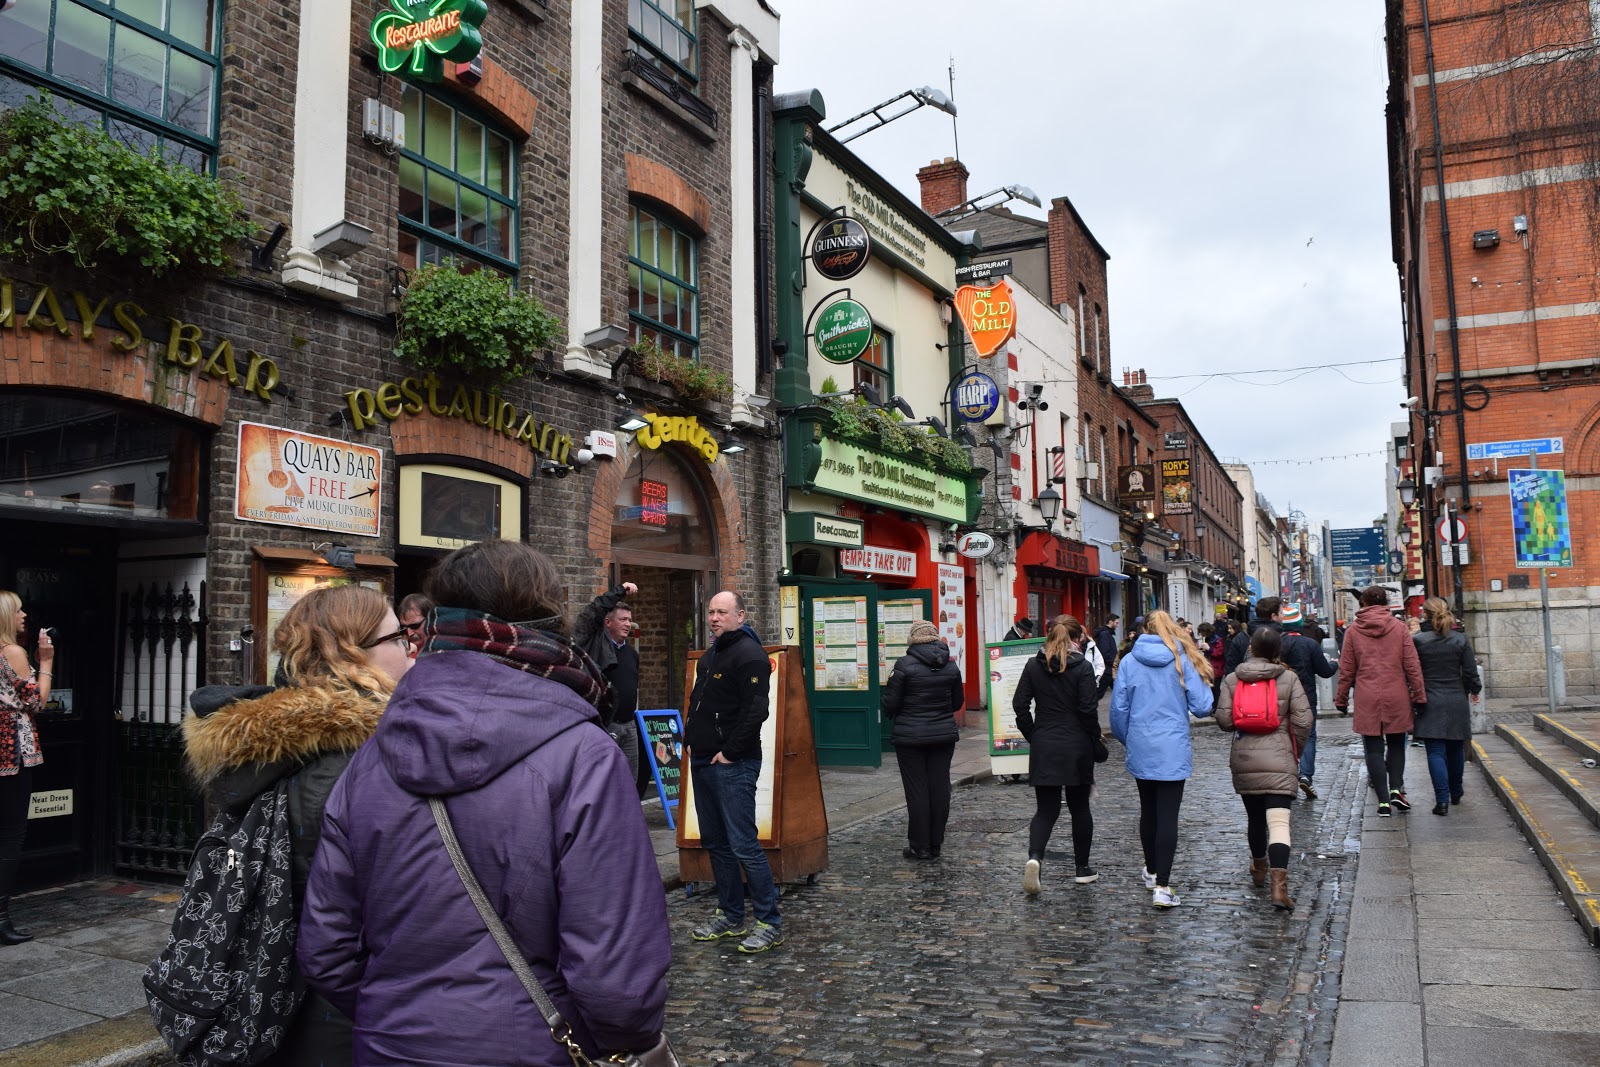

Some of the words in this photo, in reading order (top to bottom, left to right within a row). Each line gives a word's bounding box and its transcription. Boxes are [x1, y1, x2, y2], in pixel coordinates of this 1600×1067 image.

[846, 180, 861, 206] The
[862, 194, 876, 215] Old
[876, 204, 889, 226] Mill
[890, 214, 926, 254] Restaurant
[815, 235, 864, 252] GUINNESS
[970, 260, 1010, 271] RESTAURANT
[976, 290, 991, 298] THE
[972, 300, 1010, 318] OLD
[818, 316, 869, 349] Smithwick's
[973, 318, 1010, 332] MILL
[826, 342, 858, 351] DRAUGHT
[959, 384, 988, 406] HARP
[637, 412, 718, 464] Centra
[1553, 440, 1560, 450] 2
[284, 439, 341, 474] QUAYS
[346, 452, 376, 480] BAR
[1163, 460, 1189, 470] RORY'S
[857, 454, 872, 474] The
[872, 460, 886, 479] Old
[886, 464, 899, 483] Mill
[900, 468, 936, 494] Restaurant
[309, 476, 347, 500] FREE
[642, 481, 666, 498] BEERS
[284, 496, 304, 509] LIVE
[307, 498, 336, 514] MUSIC
[339, 503, 376, 519] UPSTAIRS
[642, 496, 666, 512] WINES
[246, 509, 267, 518] EVERY
[270, 511, 294, 522] FRIDAY
[302, 517, 334, 528] SATURDAY
[336, 521, 352, 530] FROM
[642, 511, 666, 525] SPIRITS
[816, 522, 859, 538] Restaurant
[840, 549, 872, 568] TEMPLE
[874, 551, 894, 572] TAKE
[897, 555, 911, 572] OUT
[653, 721, 669, 732] Pizza
[34, 804, 65, 814] Essential
